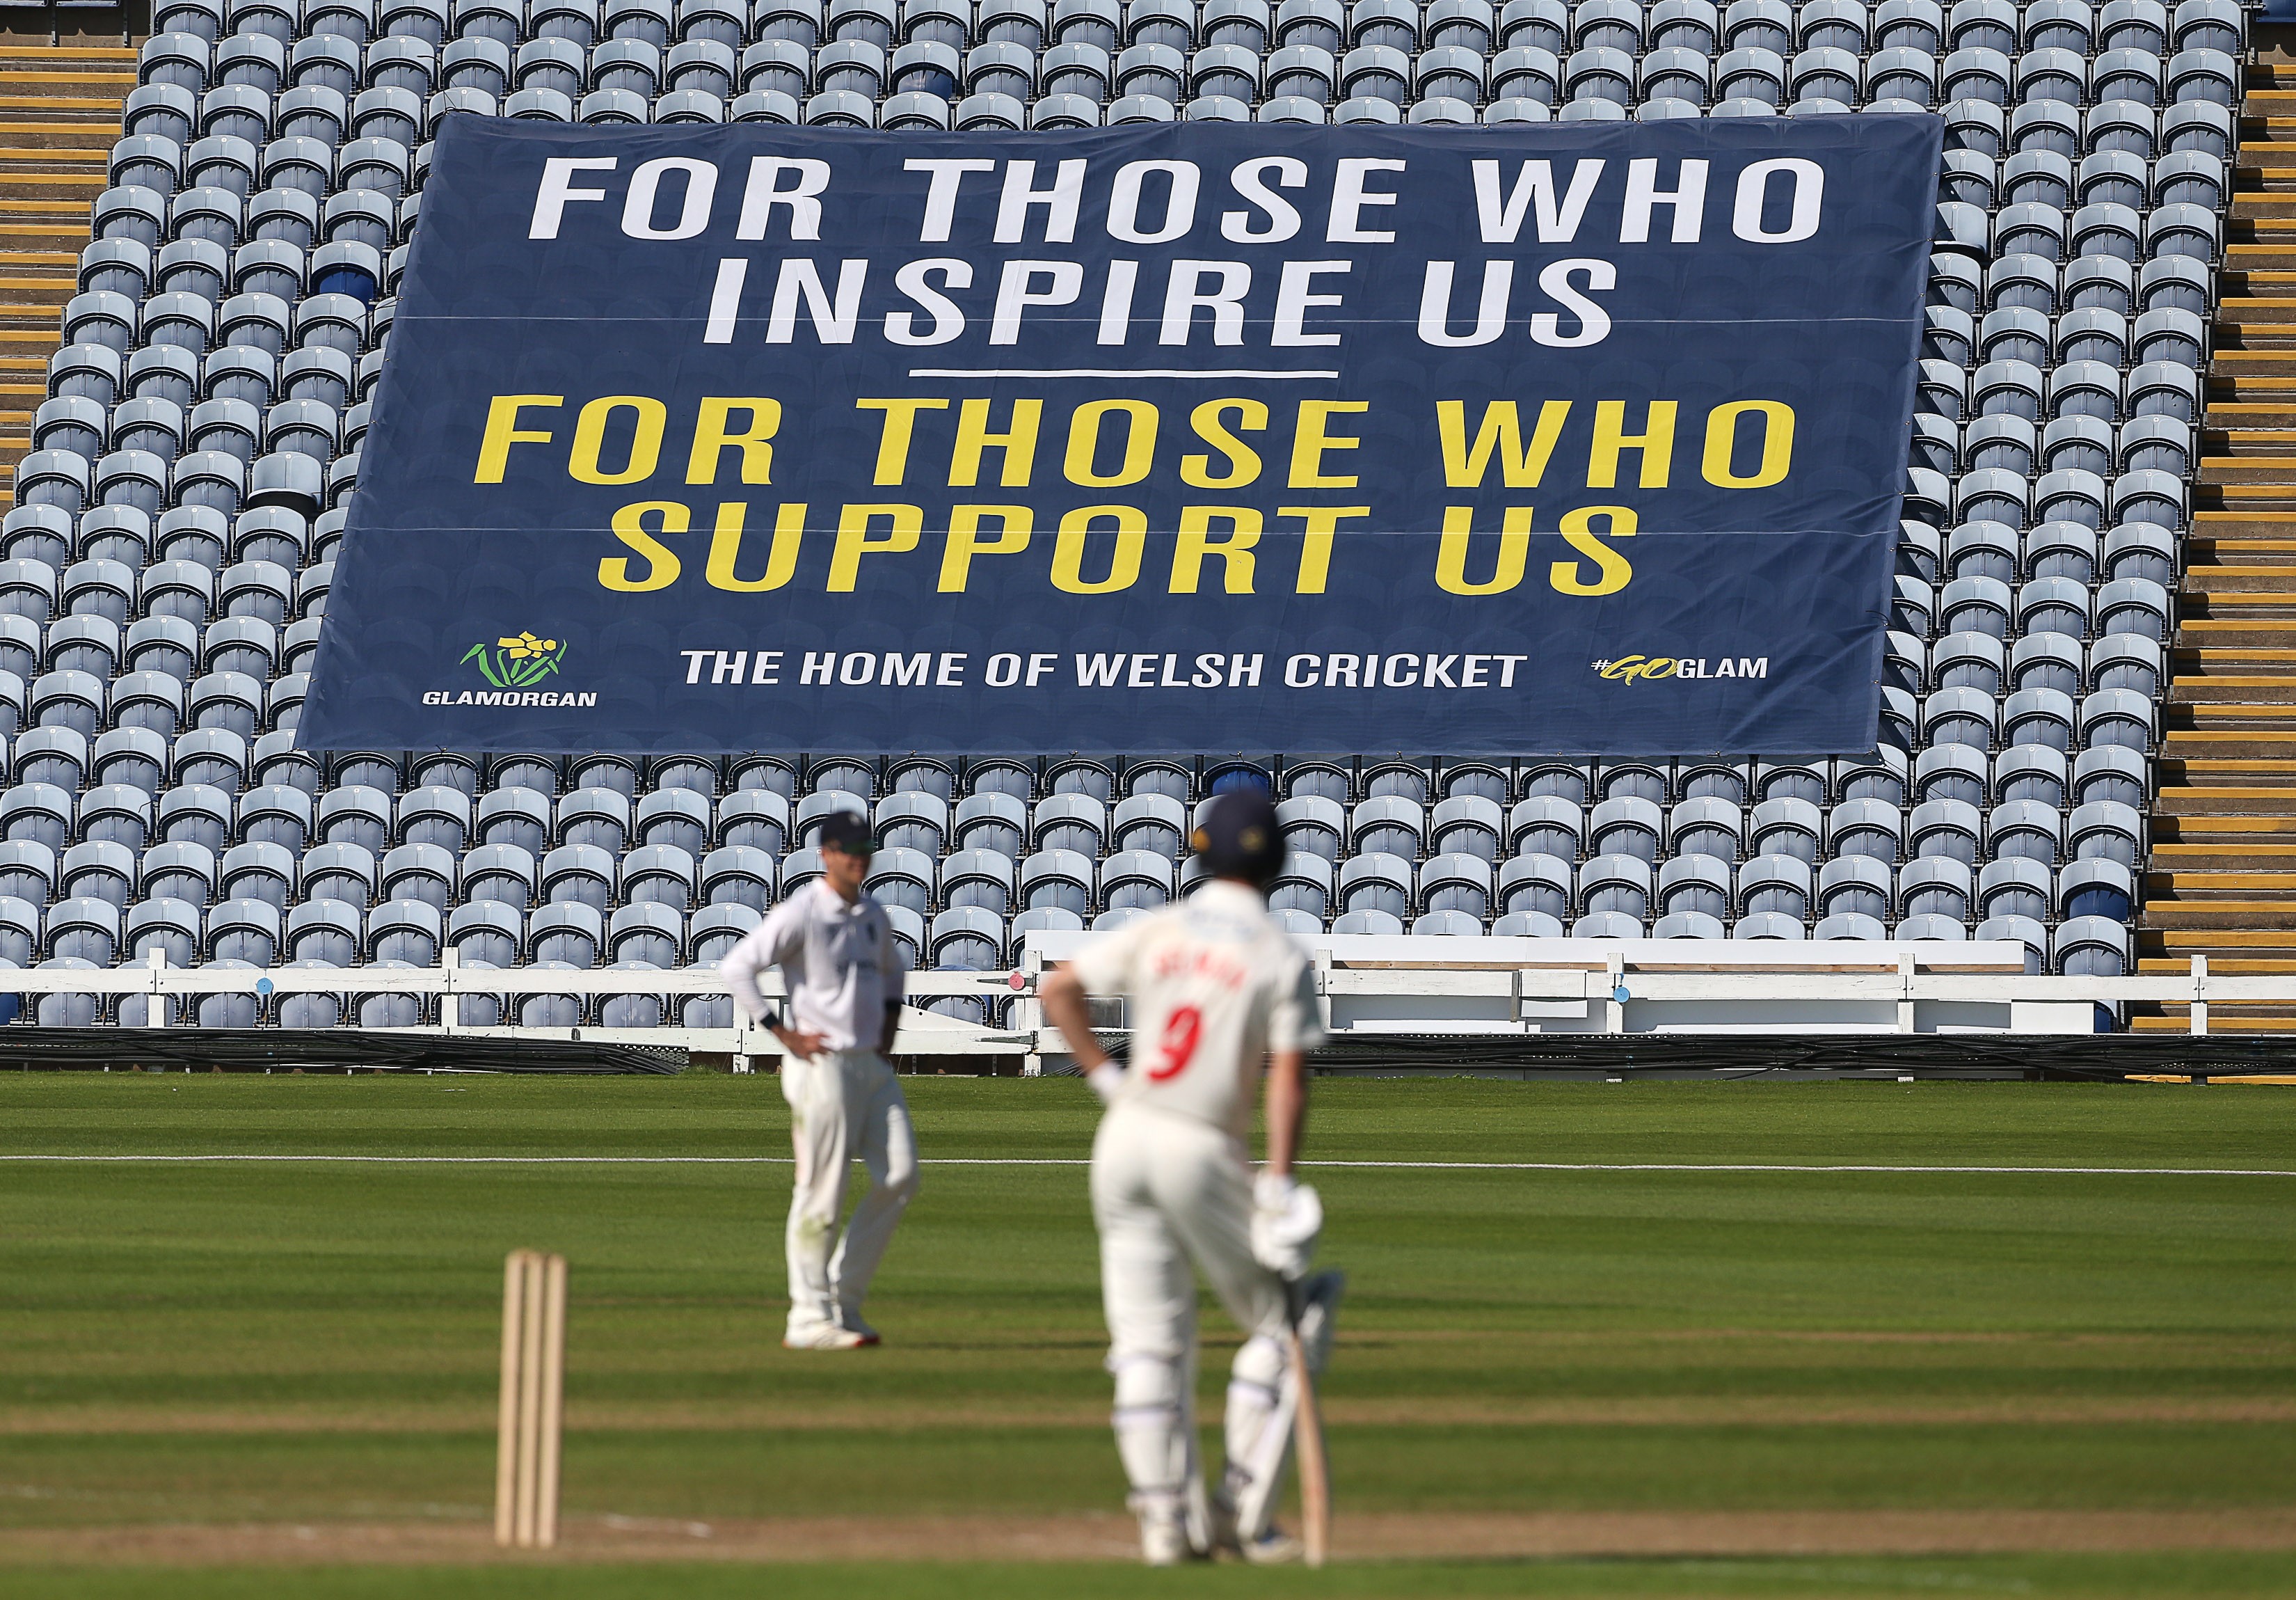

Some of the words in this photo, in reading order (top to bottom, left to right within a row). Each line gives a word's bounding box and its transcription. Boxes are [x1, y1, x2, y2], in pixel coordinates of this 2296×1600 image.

[529, 157, 830, 241] FOR
[904, 157, 1406, 244] THOSE
[1471, 157, 1824, 244] WHO
[703, 258, 1353, 347] INSPIRE
[1417, 258, 1617, 348] US
[474, 394, 782, 486] FOR
[855, 397, 1369, 489] THOSE
[1435, 399, 1795, 489] WHO
[598, 500, 1371, 594] SUPPORT
[1435, 505, 1639, 596] US
[422, 690, 598, 707] GLAMORGAN
[680, 650, 784, 684] THE
[799, 651, 968, 686] HOME
[984, 653, 1058, 687] OF
[1075, 653, 1263, 688] WELSH
[1284, 654, 1528, 688] CRICKET
[1145, 1002, 1205, 1084] 9
